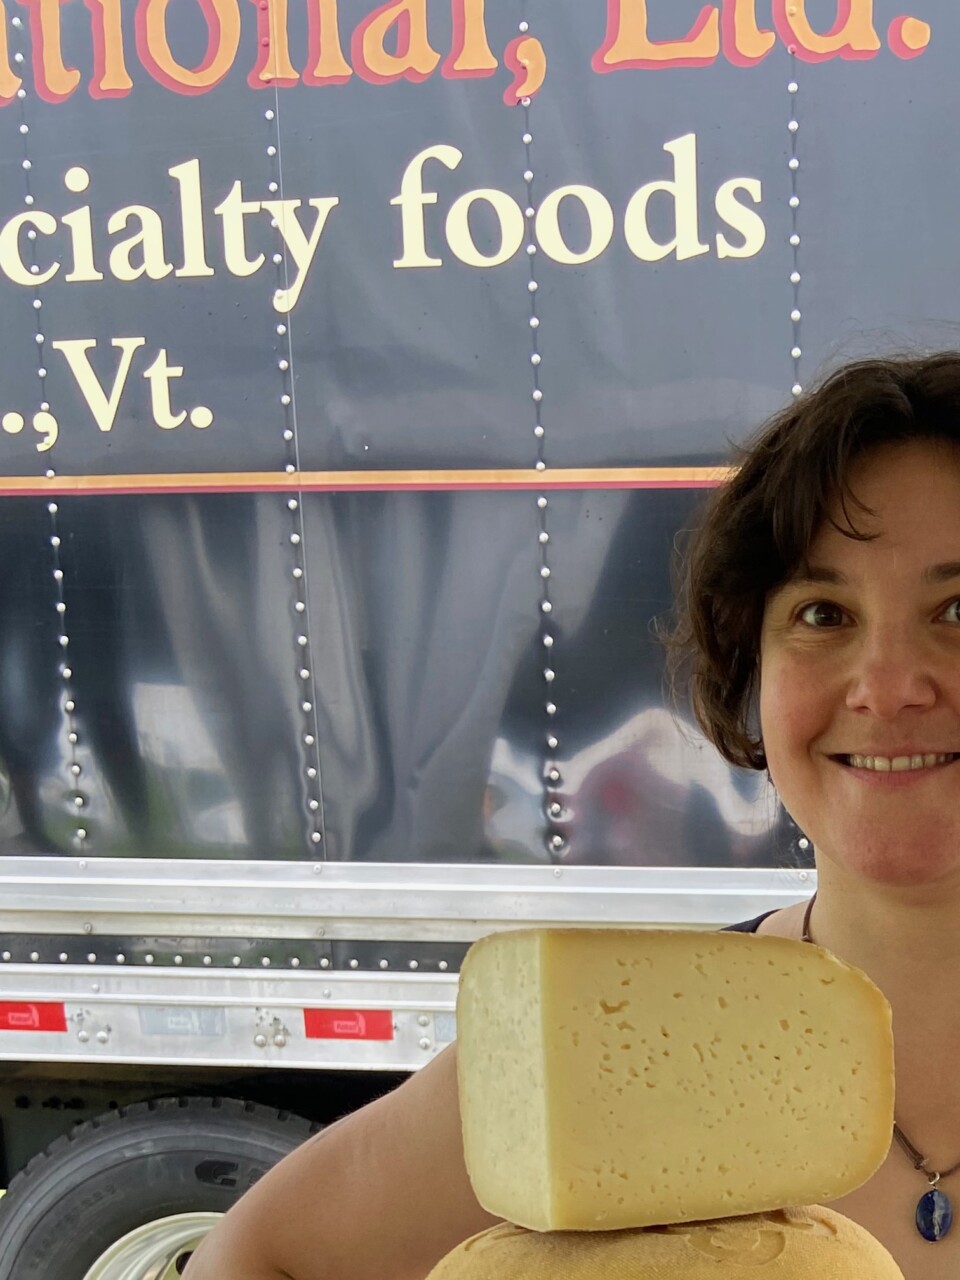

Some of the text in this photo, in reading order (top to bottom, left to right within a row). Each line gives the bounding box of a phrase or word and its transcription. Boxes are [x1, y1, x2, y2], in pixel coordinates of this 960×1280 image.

[0, 0, 546, 107] tional,
[0, 132, 768, 313] cialty foods
